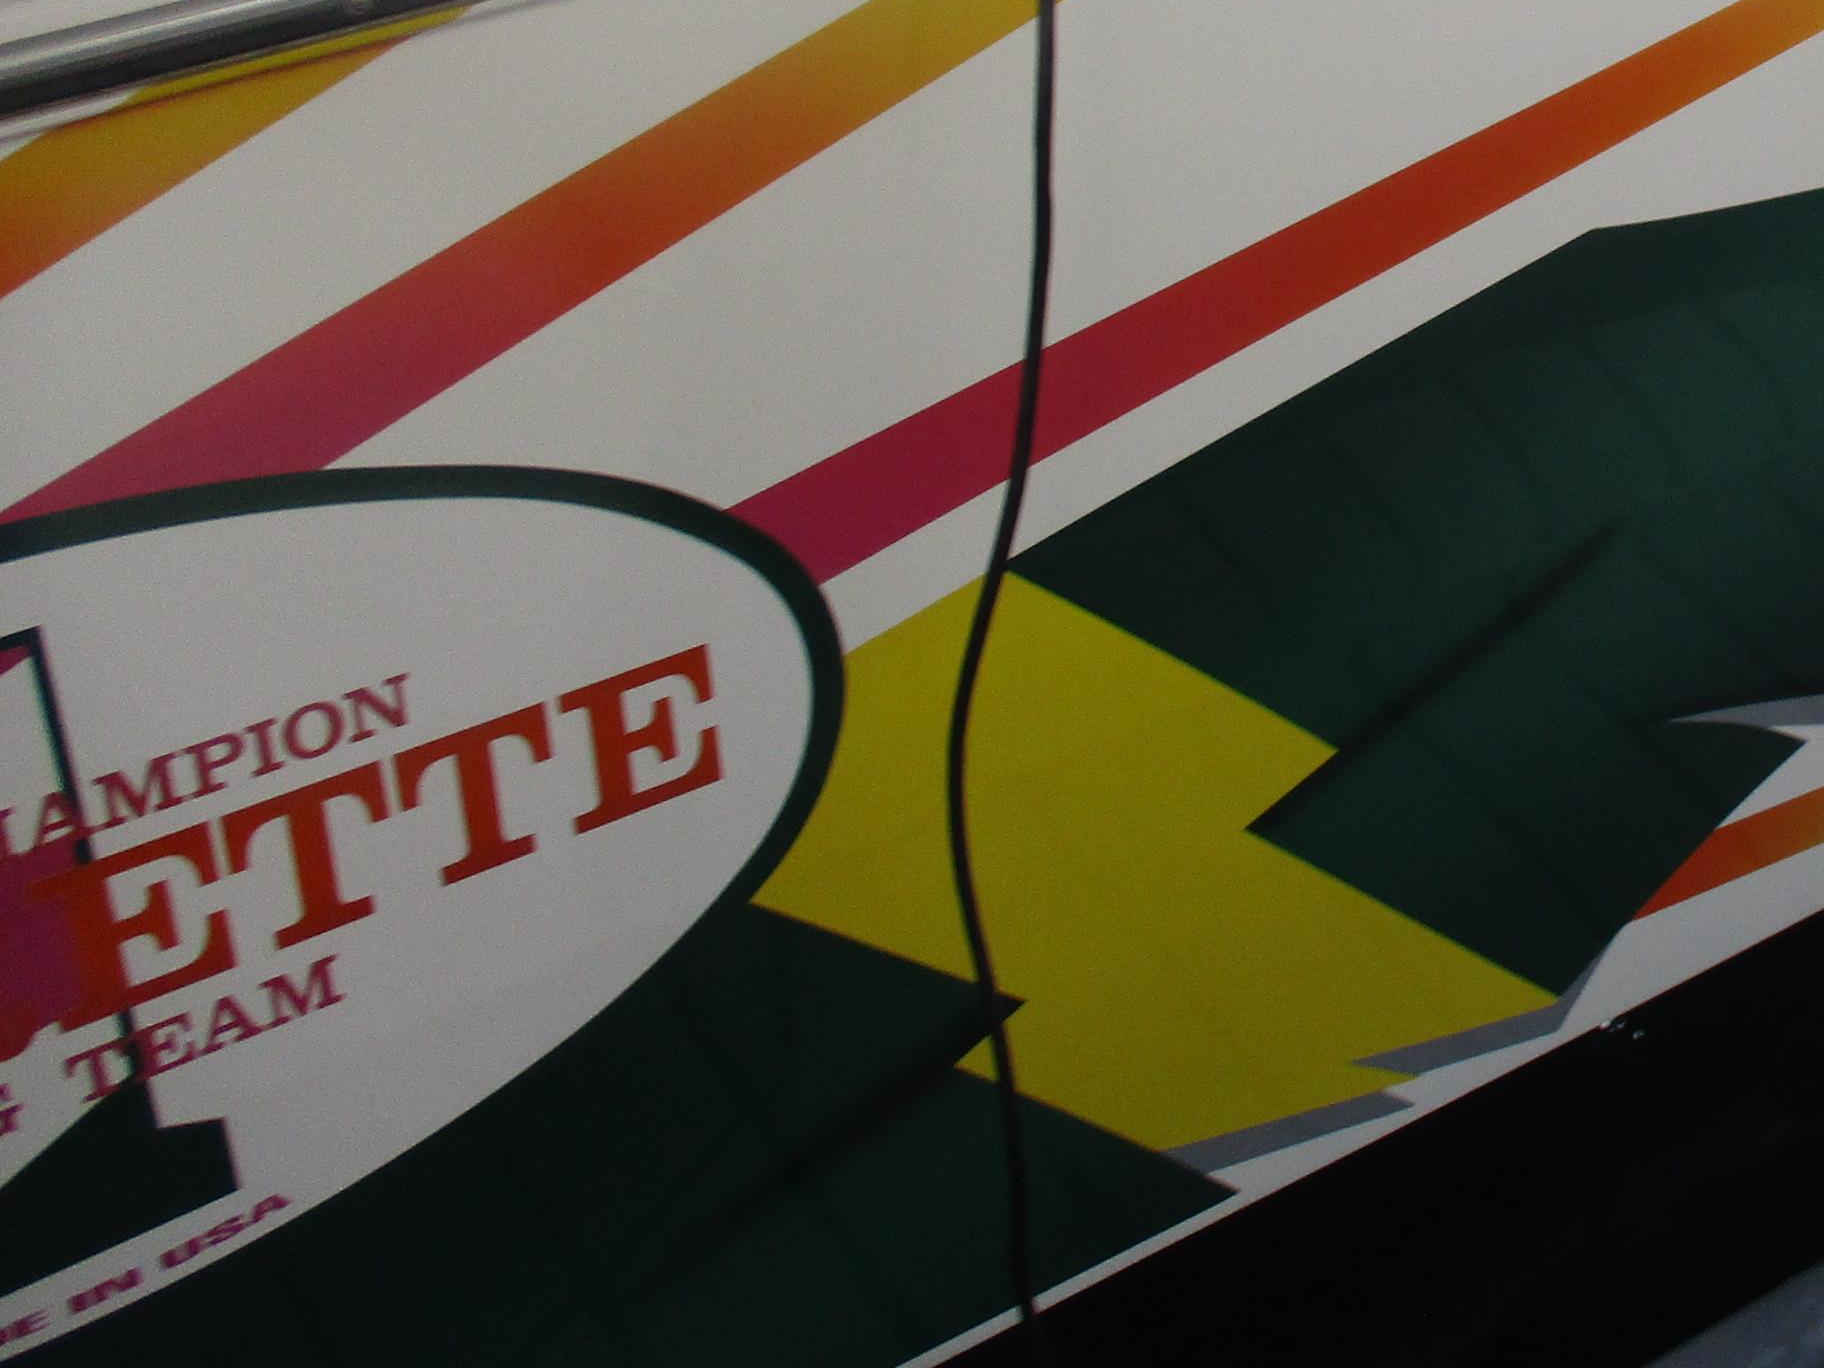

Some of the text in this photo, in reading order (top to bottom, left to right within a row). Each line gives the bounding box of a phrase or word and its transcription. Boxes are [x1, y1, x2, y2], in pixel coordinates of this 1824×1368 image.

[0, 671, 412, 860] AMPION
[0, 641, 723, 1062] ETTE
[64, 953, 348, 1103] TEAM
[67, 1266, 143, 1315] IN
[159, 1193, 294, 1270] USA
